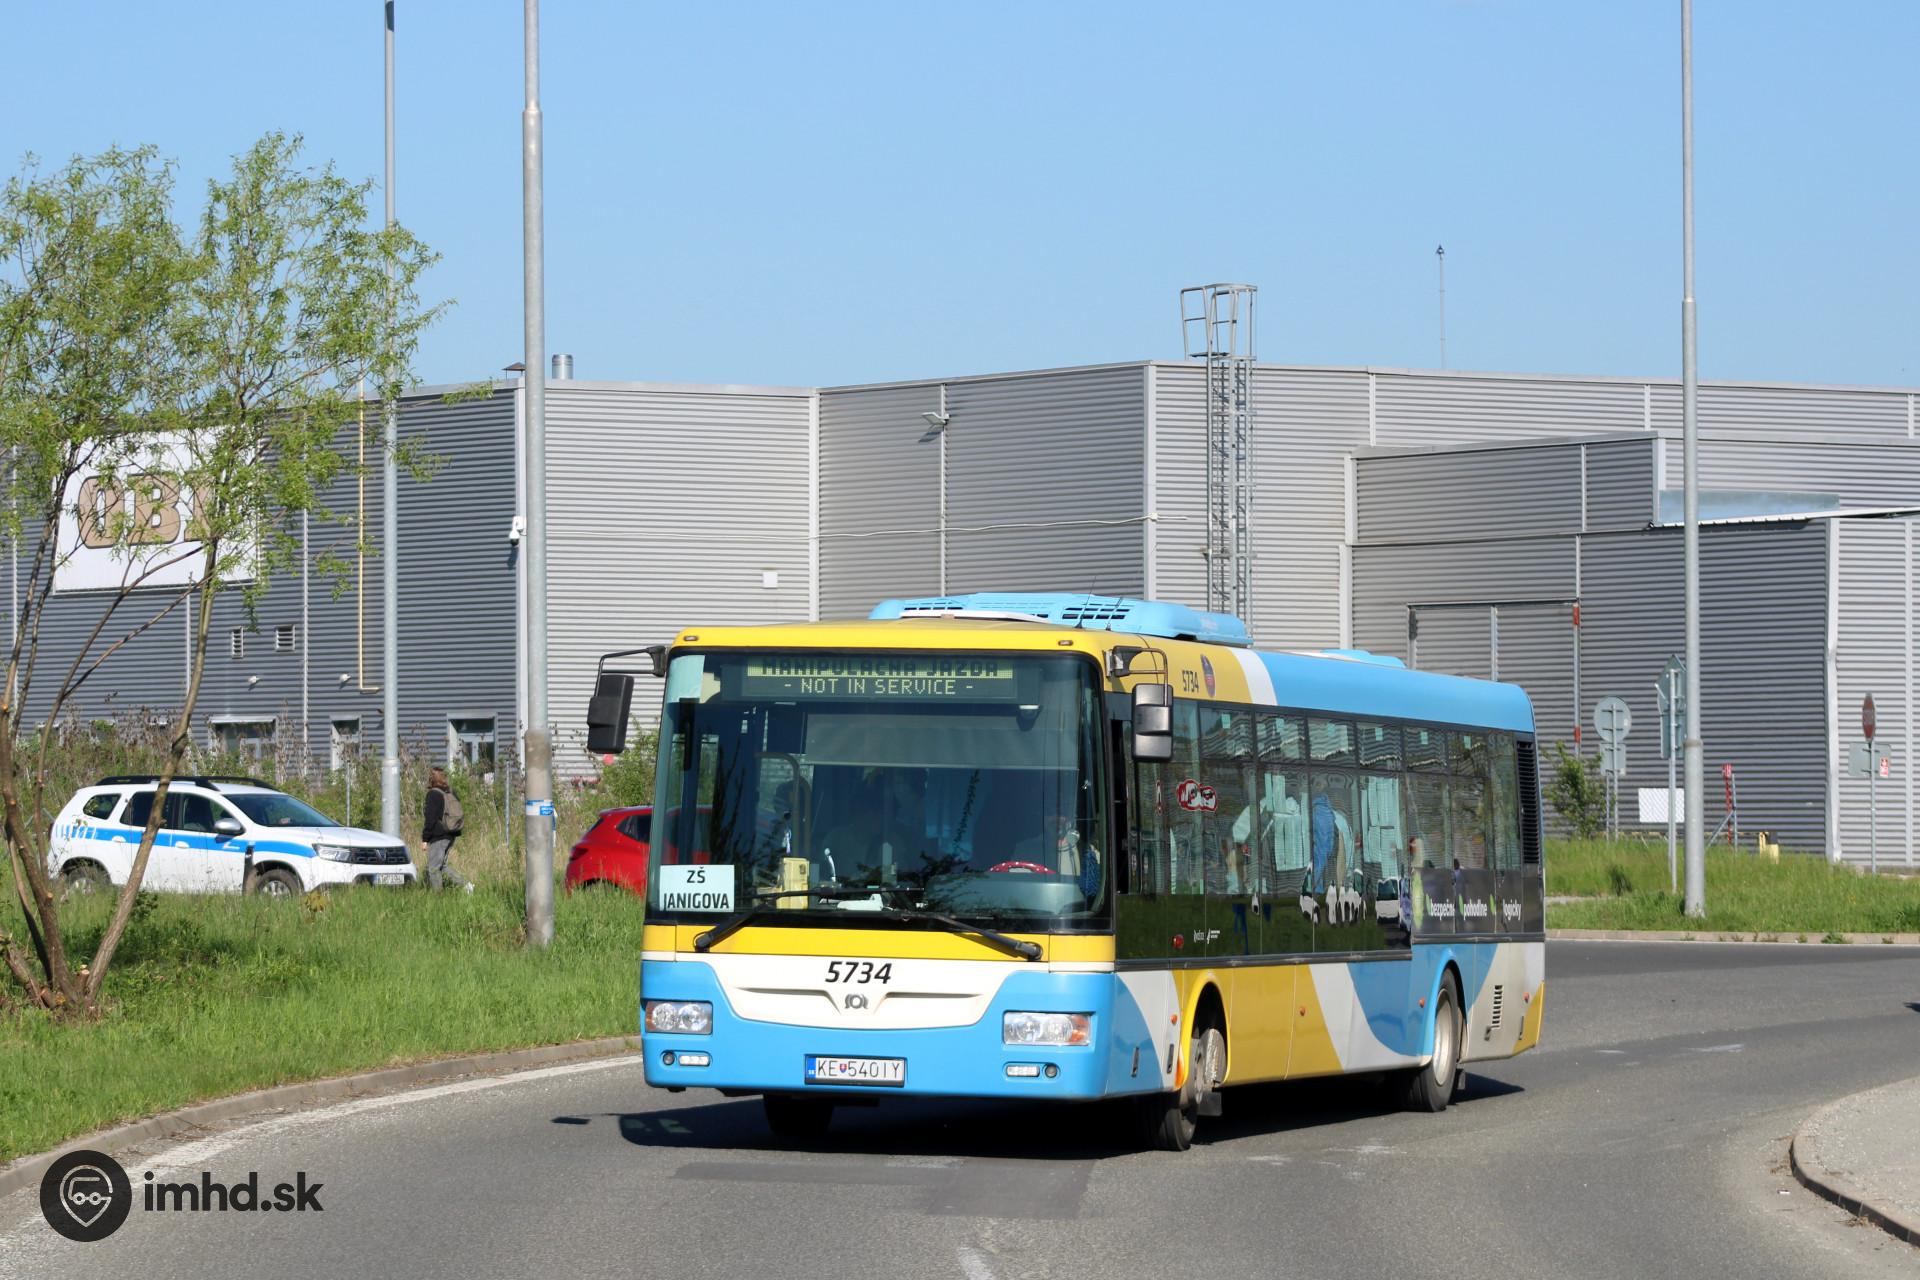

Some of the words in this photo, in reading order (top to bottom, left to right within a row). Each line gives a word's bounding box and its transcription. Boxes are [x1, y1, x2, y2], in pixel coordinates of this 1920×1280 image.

[78, 471, 222, 549] OBI
[800, 678, 839, 694] NOT
[848, 678, 866, 694] IN
[874, 679, 957, 695] SERVICE
[1182, 669, 1199, 693] 5734
[686, 866, 706, 884] ZŠ
[663, 892, 729, 911] JANIGOVA
[825, 960, 893, 985] 5734
